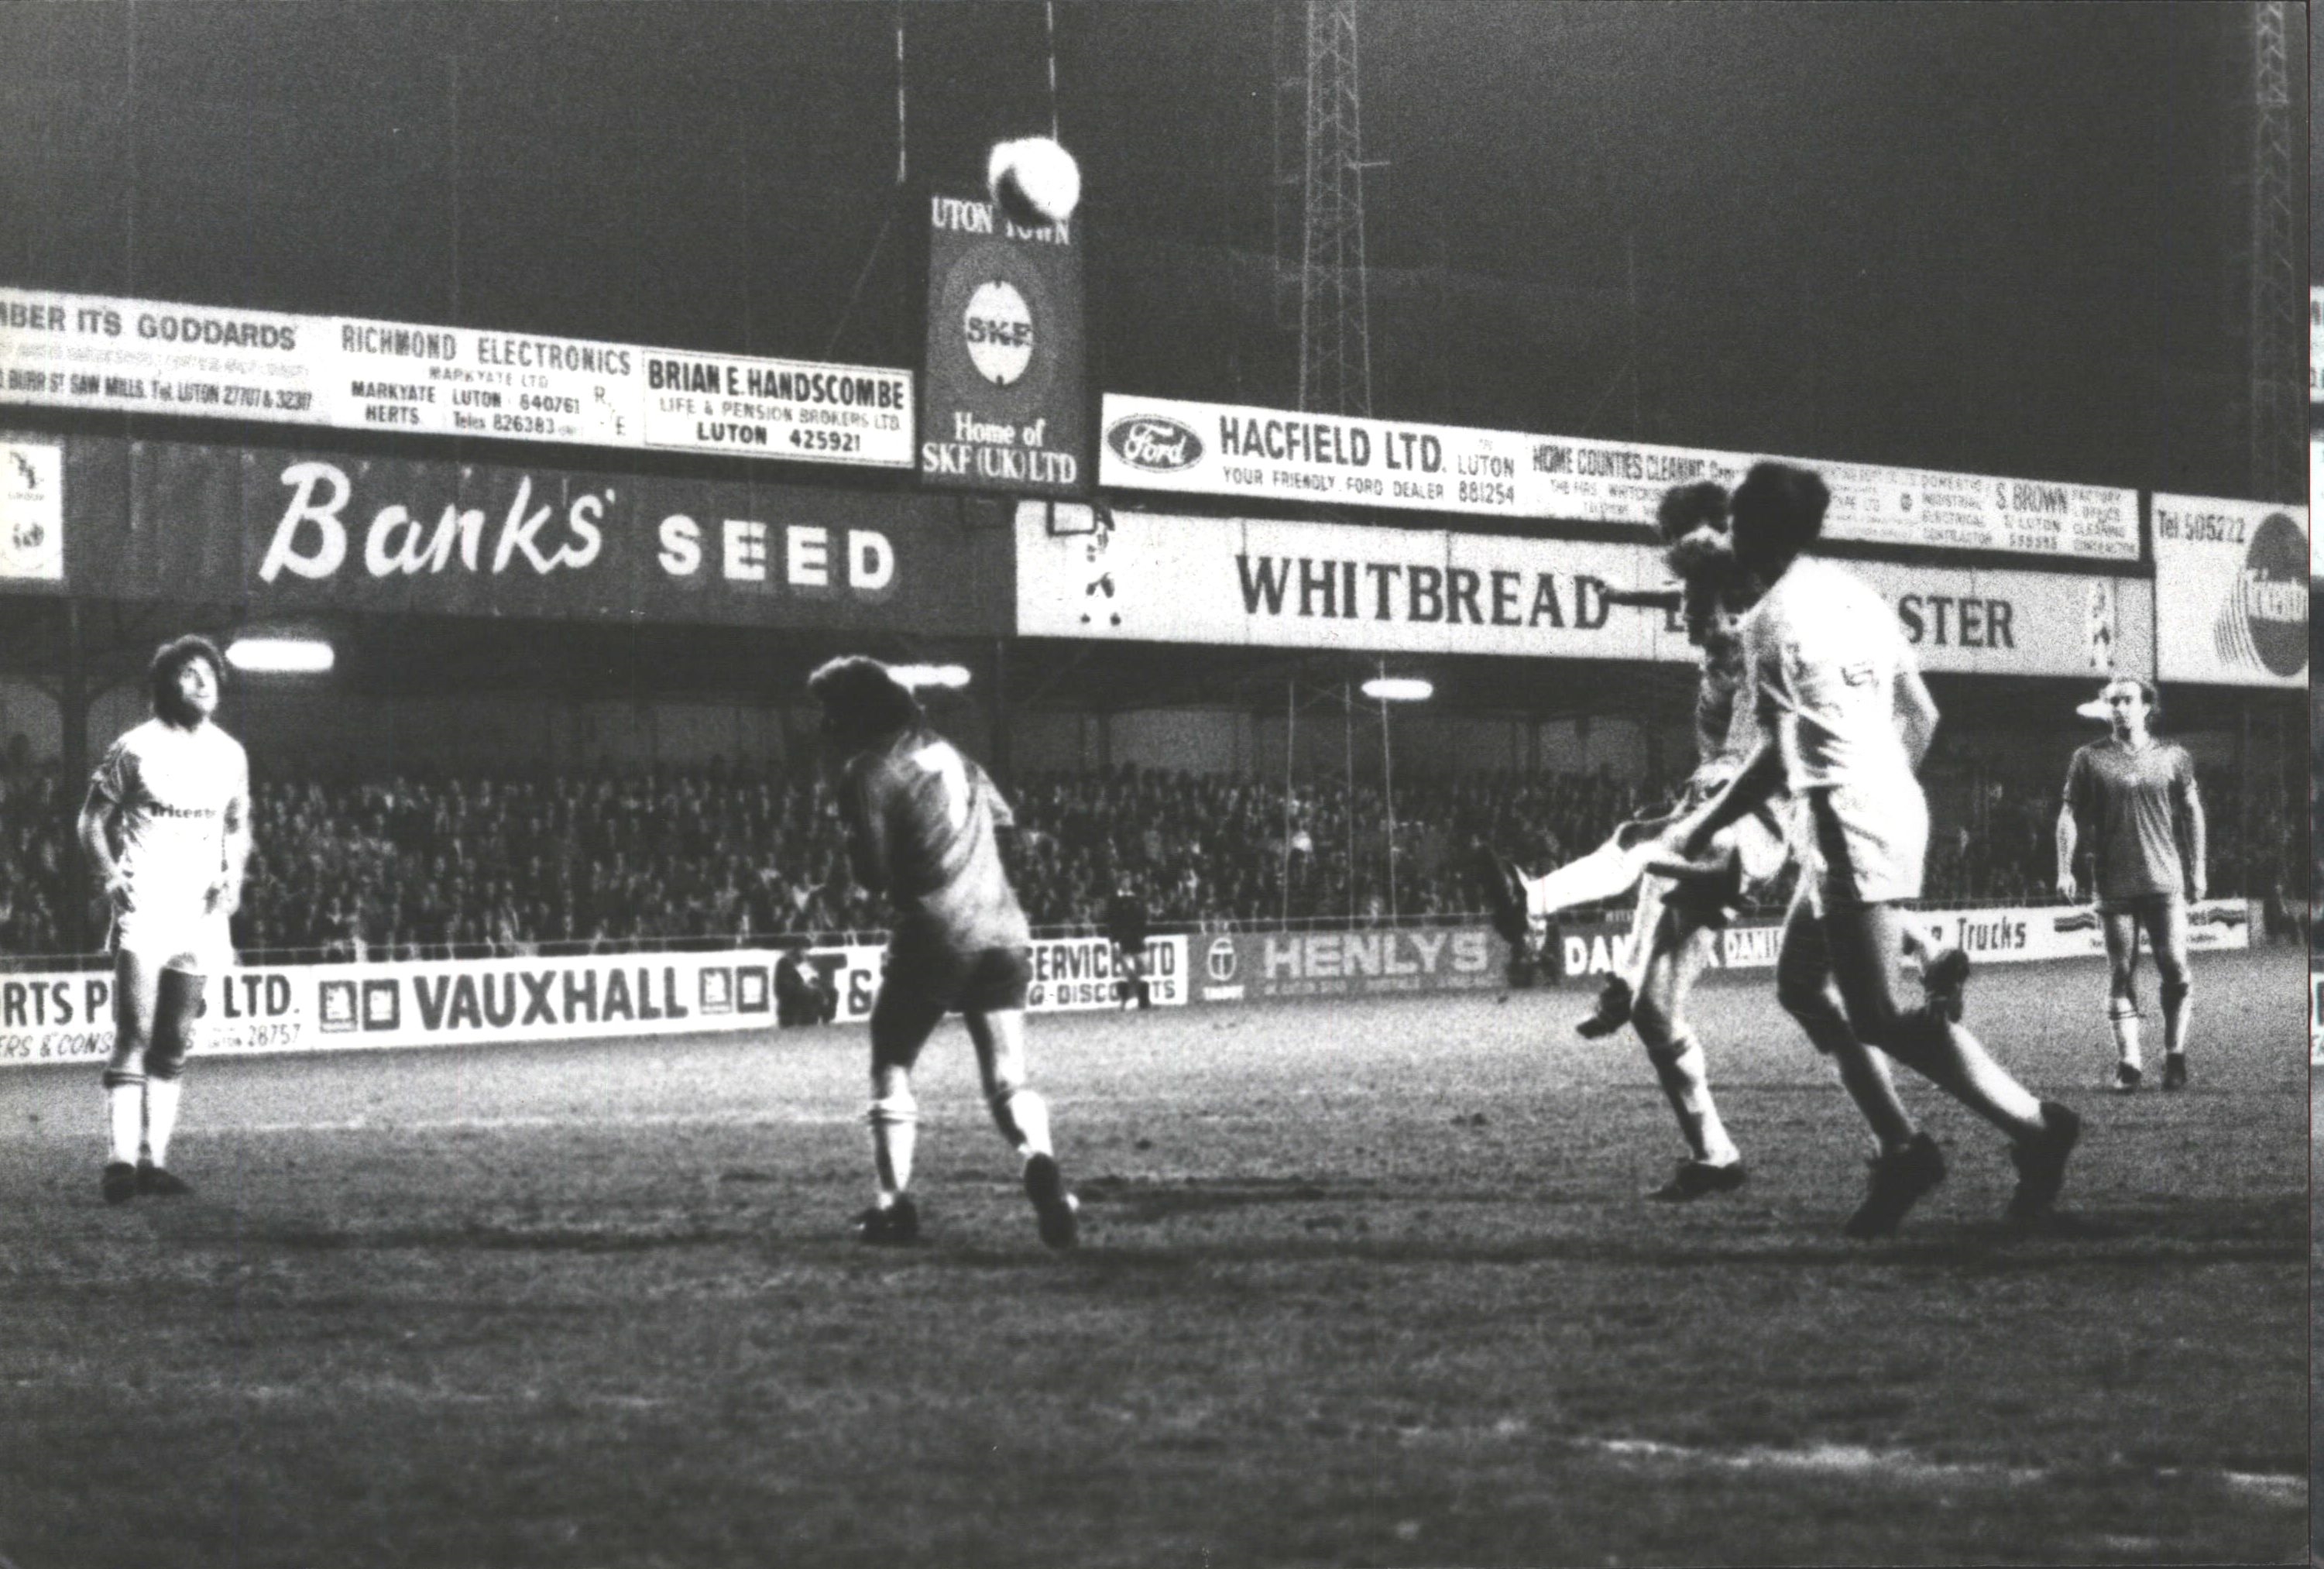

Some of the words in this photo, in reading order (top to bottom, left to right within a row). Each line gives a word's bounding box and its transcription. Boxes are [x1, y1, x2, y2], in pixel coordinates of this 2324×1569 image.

[77, 308, 122, 338] ITS
[137, 313, 297, 352] GODDARDS
[341, 324, 458, 361] RICHMOND
[477, 336, 632, 376] ELECTRONICS
[351, 380, 436, 403] MARKYATE
[452, 389, 502, 409] LUTON
[520, 393, 581, 414] 840761
[648, 359, 721, 394] BRIAN
[747, 367, 905, 410] HANDSCOMBE
[366, 403, 420, 426] HERTS
[660, 397, 697, 416] LIFE
[722, 400, 793, 423] PENSION
[799, 407, 869, 429] BROKERS
[954, 410, 1016, 445] Home
[1023, 417, 1047, 448] of
[697, 421, 768, 446] LUTON
[788, 427, 861, 452] 425921
[1123, 423, 1186, 465] Ford
[1219, 414, 1371, 468] HACFIELD
[1457, 452, 1516, 479] LUTON
[922, 441, 973, 476] SKF
[1028, 450, 1077, 484] LTD
[1224, 465, 1264, 486] YOUR
[1272, 469, 1336, 494] FRIENDLY
[1347, 476, 1383, 498] FORD
[1393, 480, 1445, 501] DEALER
[658, 513, 894, 590] SEED
[1234, 554, 1610, 630] WHITBREAD
[1957, 915, 2027, 951] Trucks
[1264, 932, 1488, 980] HENLYS
[413, 966, 688, 1031] VAUXHALL
